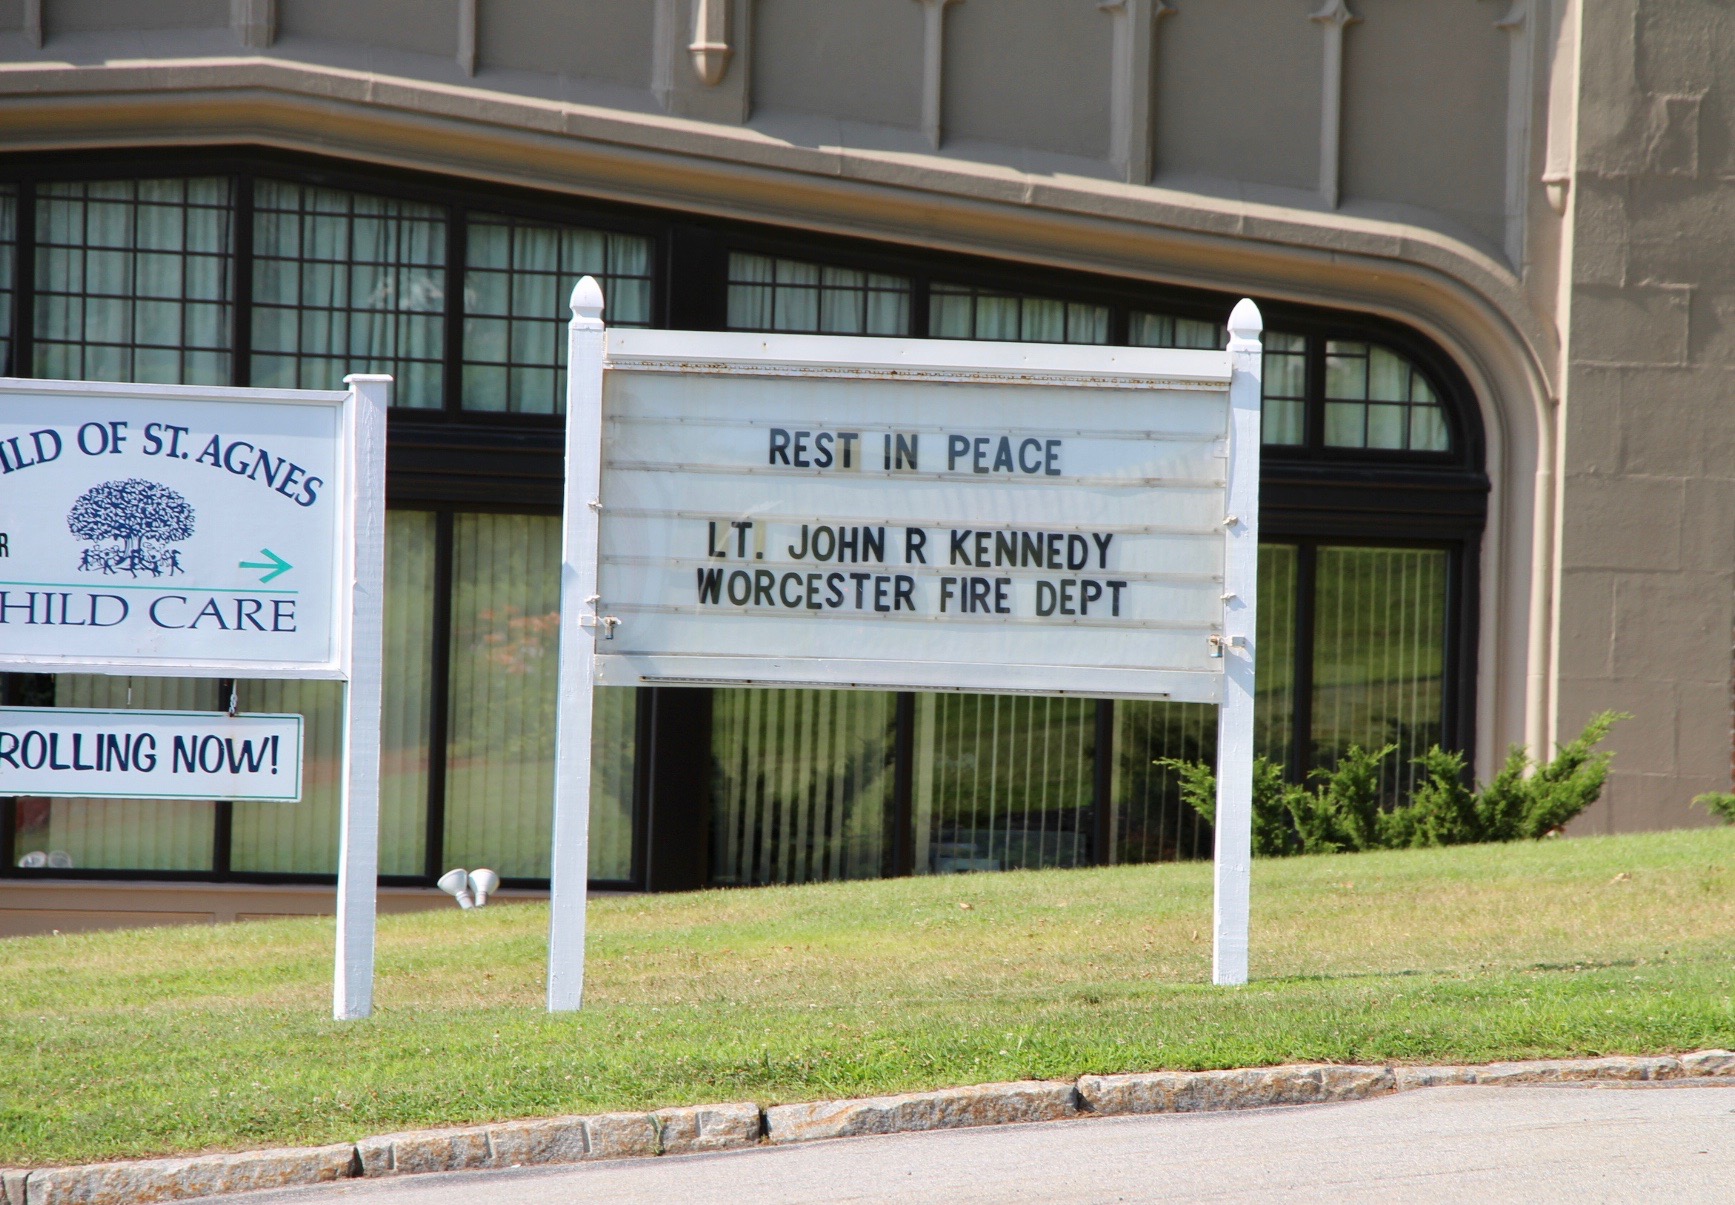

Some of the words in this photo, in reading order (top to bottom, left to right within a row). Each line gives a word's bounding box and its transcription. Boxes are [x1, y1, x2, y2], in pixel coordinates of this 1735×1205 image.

[77, 421, 127, 456] OF
[143, 422, 189, 460] ST.
[195, 434, 323, 507] AGNES
[768, 428, 858, 469] REST
[884, 433, 917, 470] IN
[948, 434, 1061, 476] PEACE
[708, 521, 763, 560] LT.
[788, 524, 885, 563] JOHN
[905, 528, 926, 564] R
[950, 529, 1114, 570] KENNEDY
[149, 595, 297, 632] CARE
[697, 568, 915, 611] WORCESTER
[940, 577, 1011, 614] FIRE
[1036, 579, 1127, 617] DEPT
[172, 734, 279, 775] NOW!
